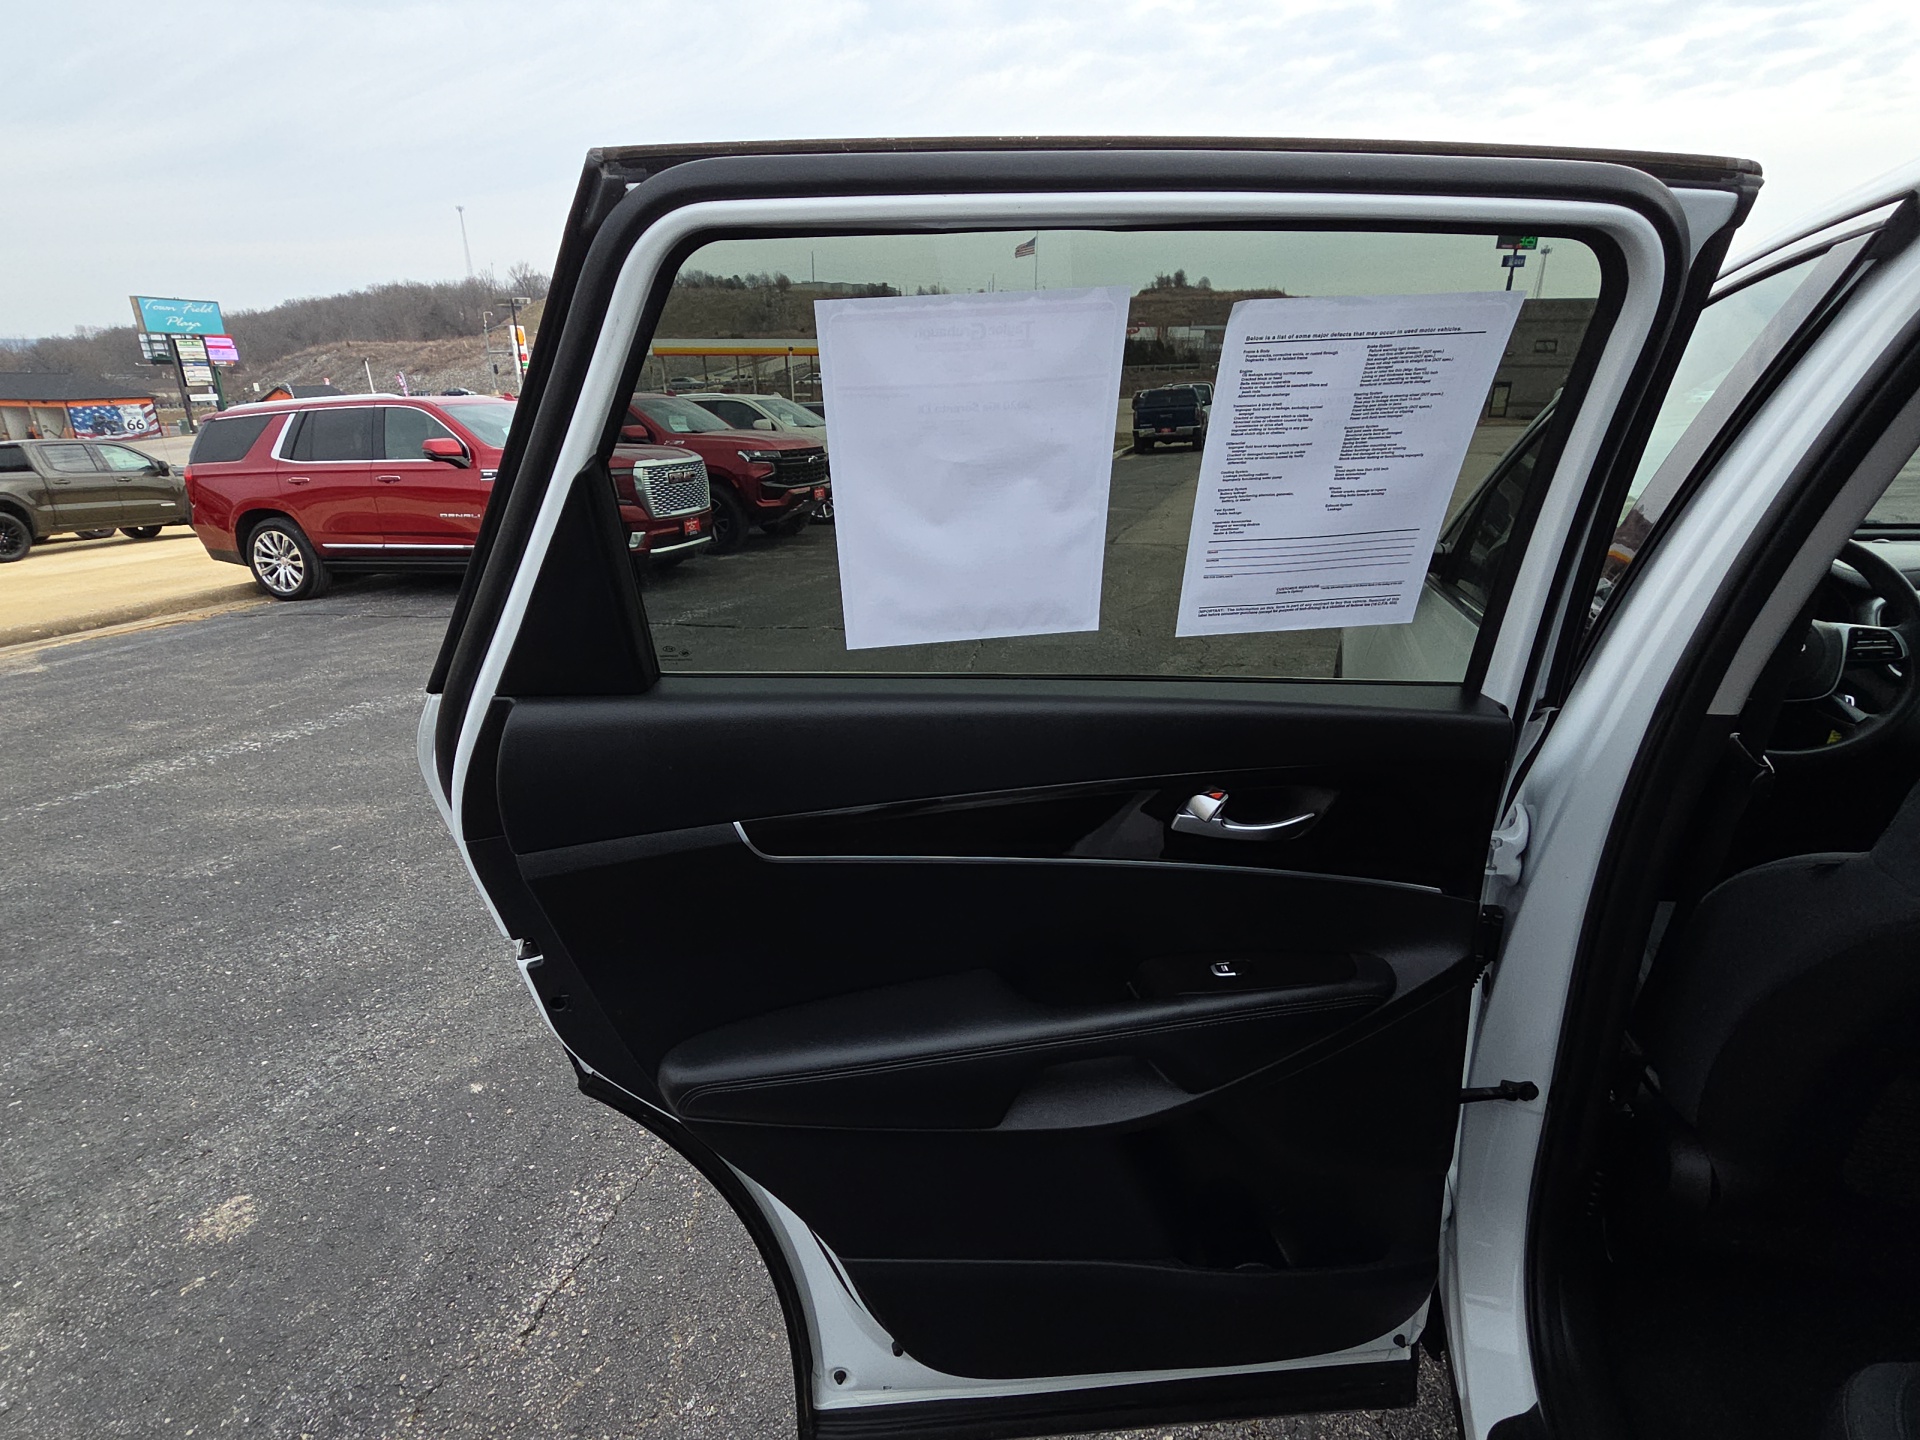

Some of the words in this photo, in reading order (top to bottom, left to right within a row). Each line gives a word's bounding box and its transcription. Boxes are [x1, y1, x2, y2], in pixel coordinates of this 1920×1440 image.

[144, 300, 176, 311] Town
[182, 302, 214, 314] Field
[127, 419, 145, 430] 66
